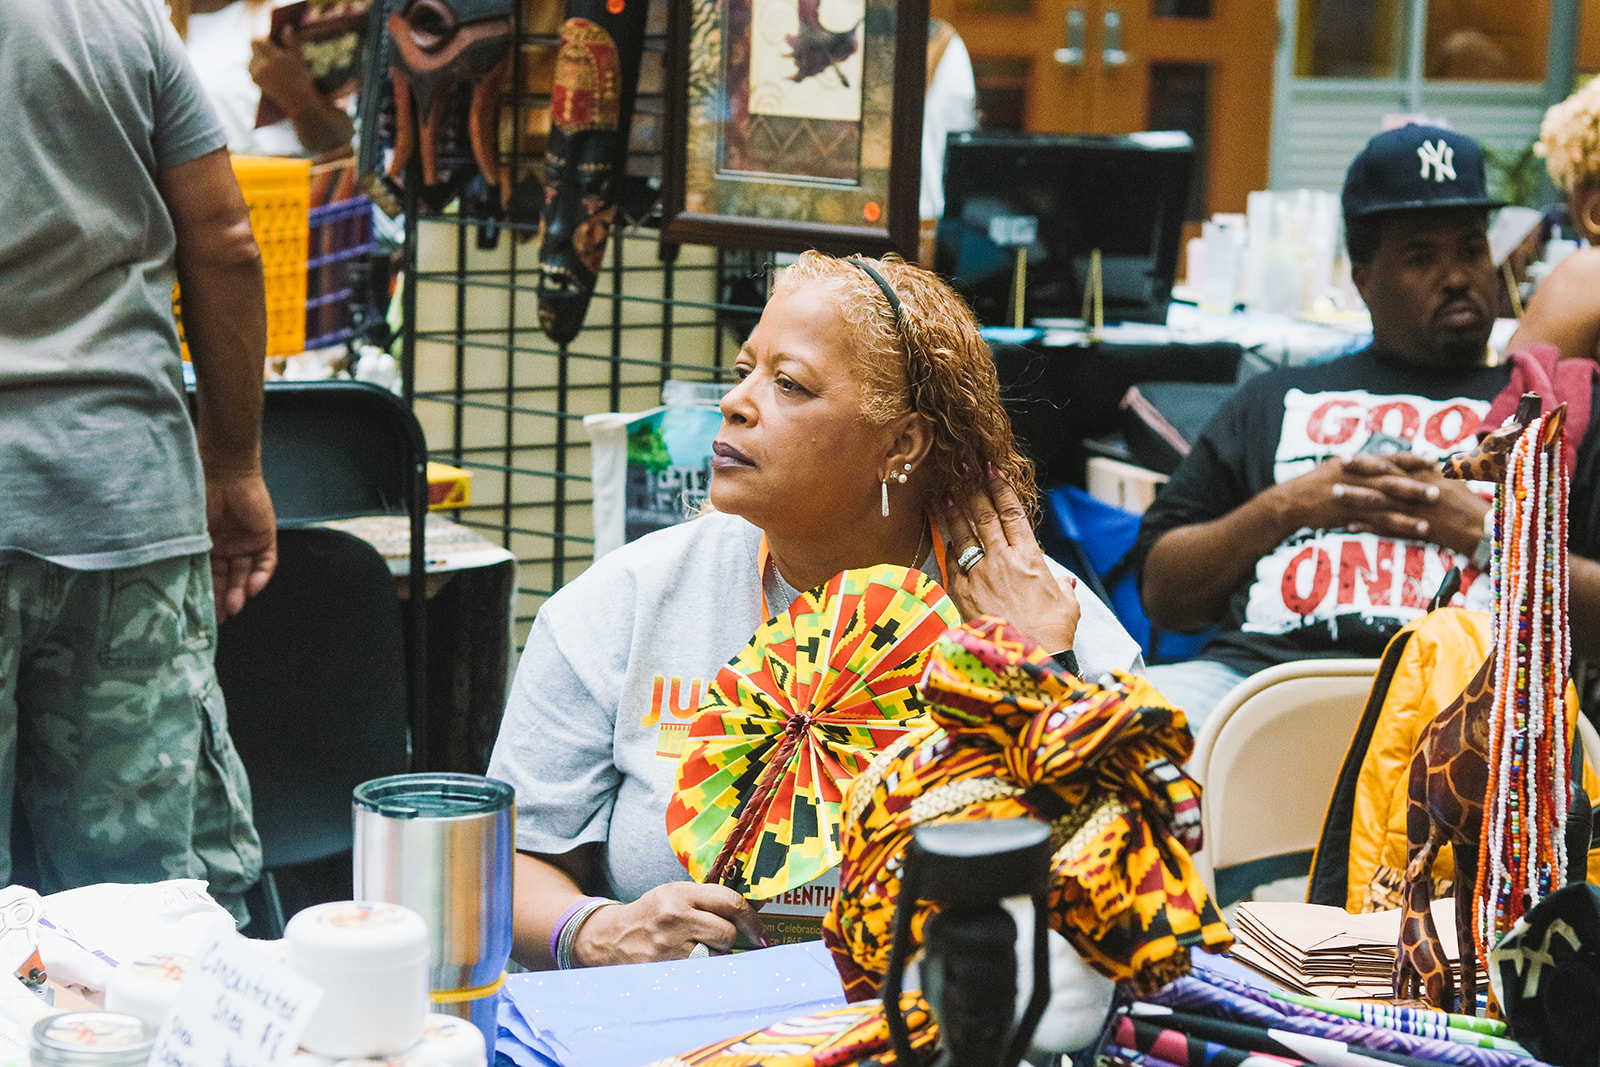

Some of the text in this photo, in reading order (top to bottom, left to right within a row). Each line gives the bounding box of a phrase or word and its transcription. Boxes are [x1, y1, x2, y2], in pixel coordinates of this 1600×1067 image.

[1417, 139, 1457, 182] NY
[1306, 400, 1482, 450] GOO
[641, 674, 712, 727] JU
[668, 732, 689, 752] Fr
[777, 922, 821, 935] Celebratio
